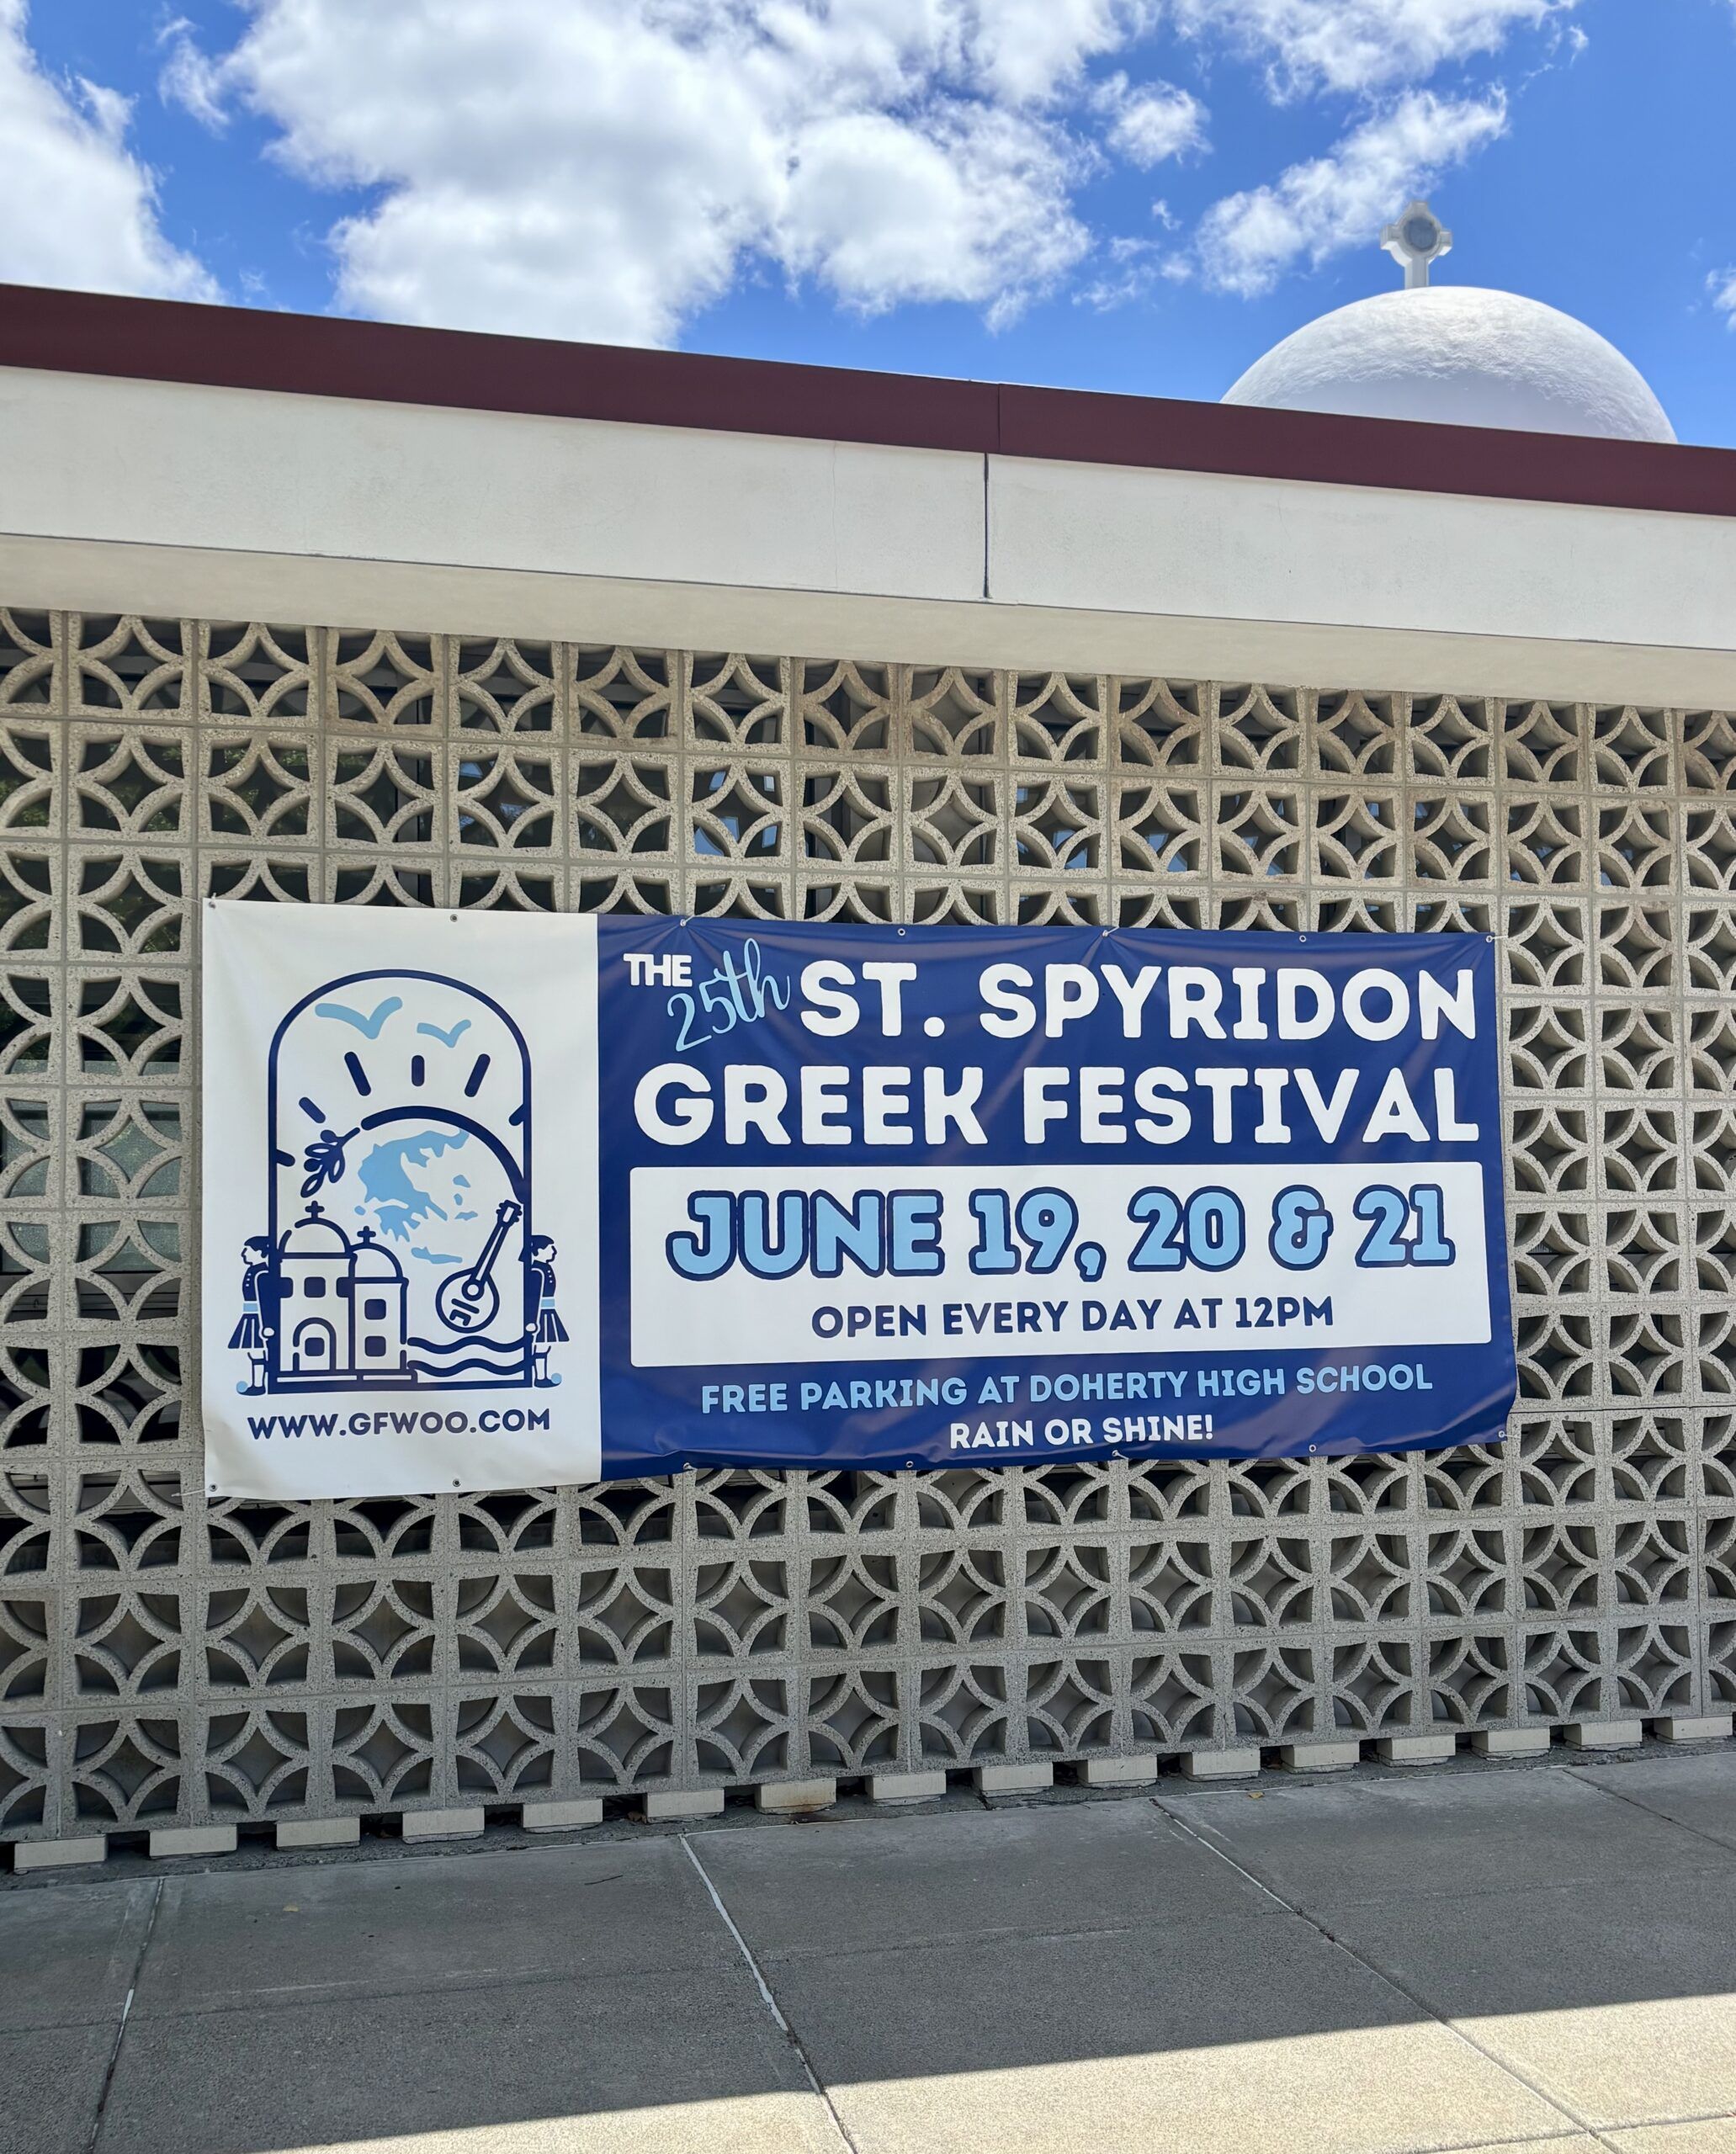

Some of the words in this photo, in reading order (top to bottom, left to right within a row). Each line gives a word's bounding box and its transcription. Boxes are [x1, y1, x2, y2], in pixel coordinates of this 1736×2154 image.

[624, 952, 693, 988] THE
[666, 937, 791, 1052] 25th
[800, 959, 945, 1037] ST.
[979, 963, 1476, 1041] SPYRIDON
[634, 1063, 988, 1145] GREEK
[1023, 1066, 1480, 1144] FESTIVAL
[666, 1189, 945, 1281] JUNE
[968, 1186, 1107, 1282] 19,
[1127, 1185, 1246, 1272] 20
[1268, 1184, 1334, 1271] &
[1352, 1184, 1456, 1269] 21
[811, 1304, 926, 1339] OPEN
[943, 1301, 1069, 1336] EVERY
[1082, 1299, 1162, 1332] DAY
[1173, 1297, 1223, 1329] AT
[1235, 1296, 1334, 1329] 12PM
[701, 1382, 788, 1414] FREE
[800, 1377, 968, 1411] PARKING
[977, 1376, 1021, 1404] AT
[1030, 1370, 1188, 1403] DOHERTY
[1197, 1366, 1286, 1398] HIGH
[1296, 1363, 1433, 1395] SCHOOL
[247, 1408, 550, 1440] WWW.GFWOO.COM
[949, 1419, 1034, 1450] RAIN
[1044, 1418, 1092, 1446] OR
[1102, 1414, 1214, 1443] SHINE!
